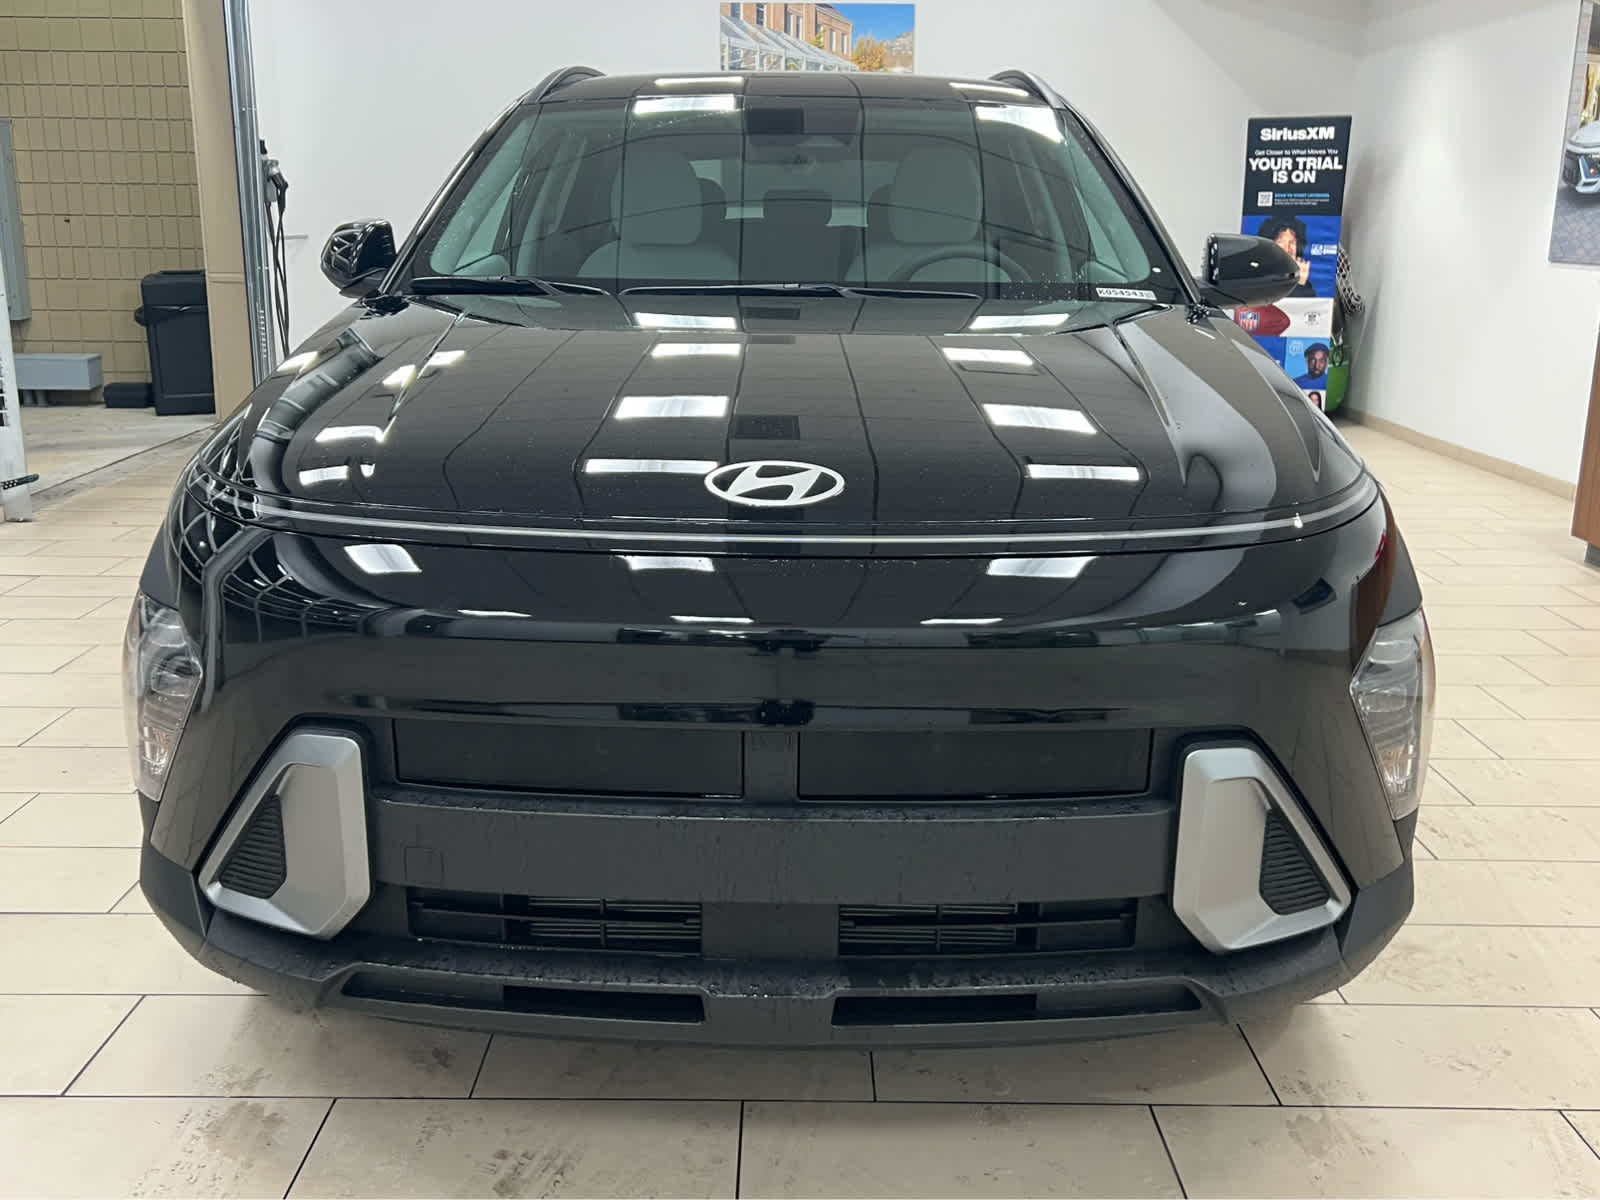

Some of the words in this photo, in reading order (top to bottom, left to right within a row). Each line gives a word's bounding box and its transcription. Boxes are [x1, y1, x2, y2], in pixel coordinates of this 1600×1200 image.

[1260, 126, 1335, 141] SiriusXM
[1249, 157, 1293, 171] YOUR
[1296, 156, 1343, 170] TRIAL
[1273, 170, 1289, 184] IS
[1291, 170, 1316, 183] ON
